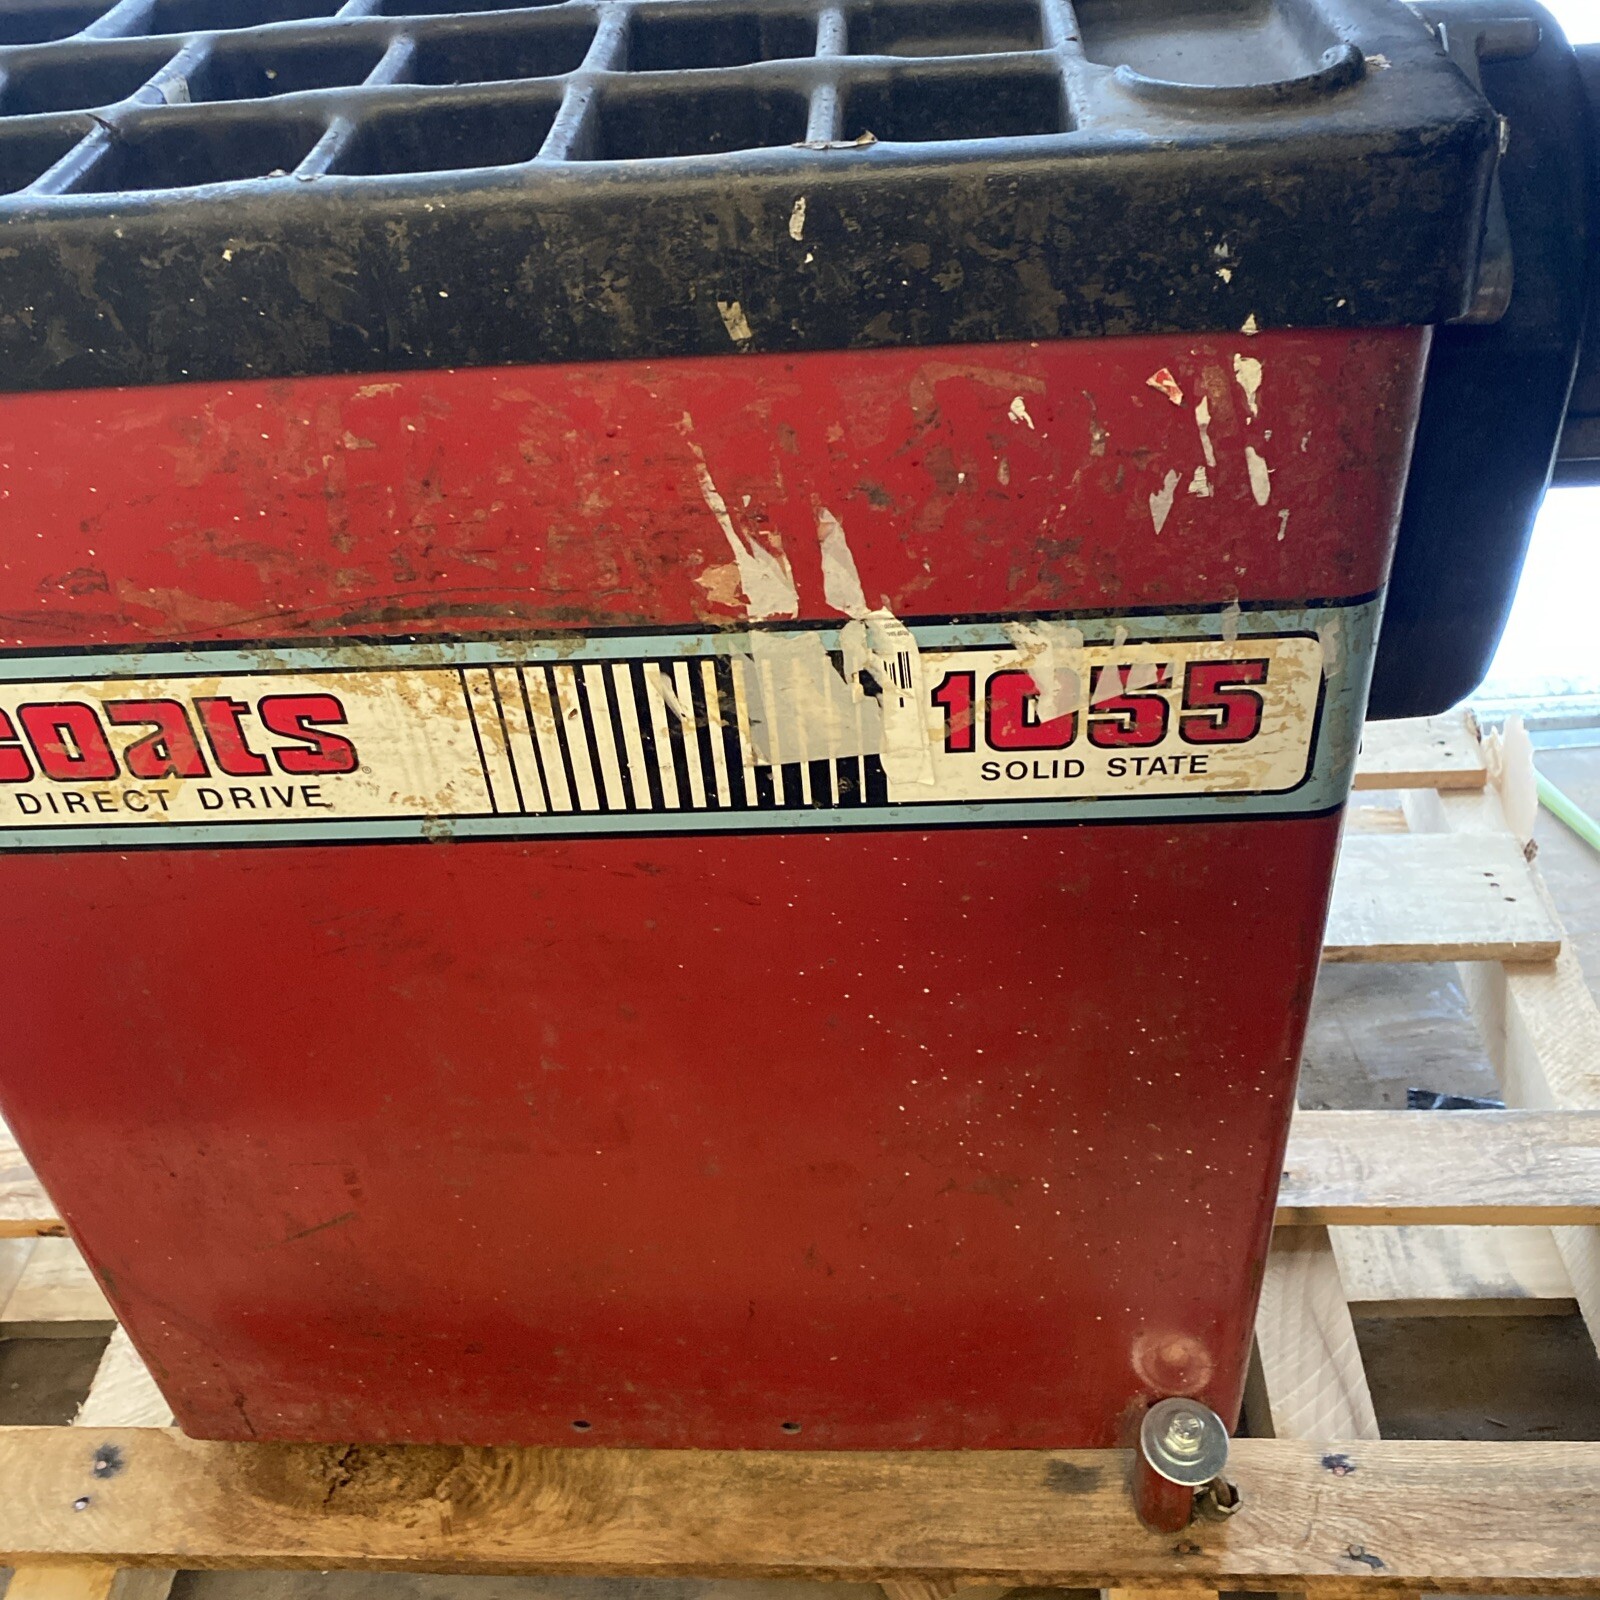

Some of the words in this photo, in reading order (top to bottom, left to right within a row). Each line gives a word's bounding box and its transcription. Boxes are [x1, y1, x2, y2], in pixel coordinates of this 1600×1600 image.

[931, 657, 1269, 753] 1055
[981, 759, 1085, 781] SOLID
[1106, 755, 1209, 777] STATE
[15, 790, 170, 815] DIRECT
[197, 785, 326, 810] DRIVE
